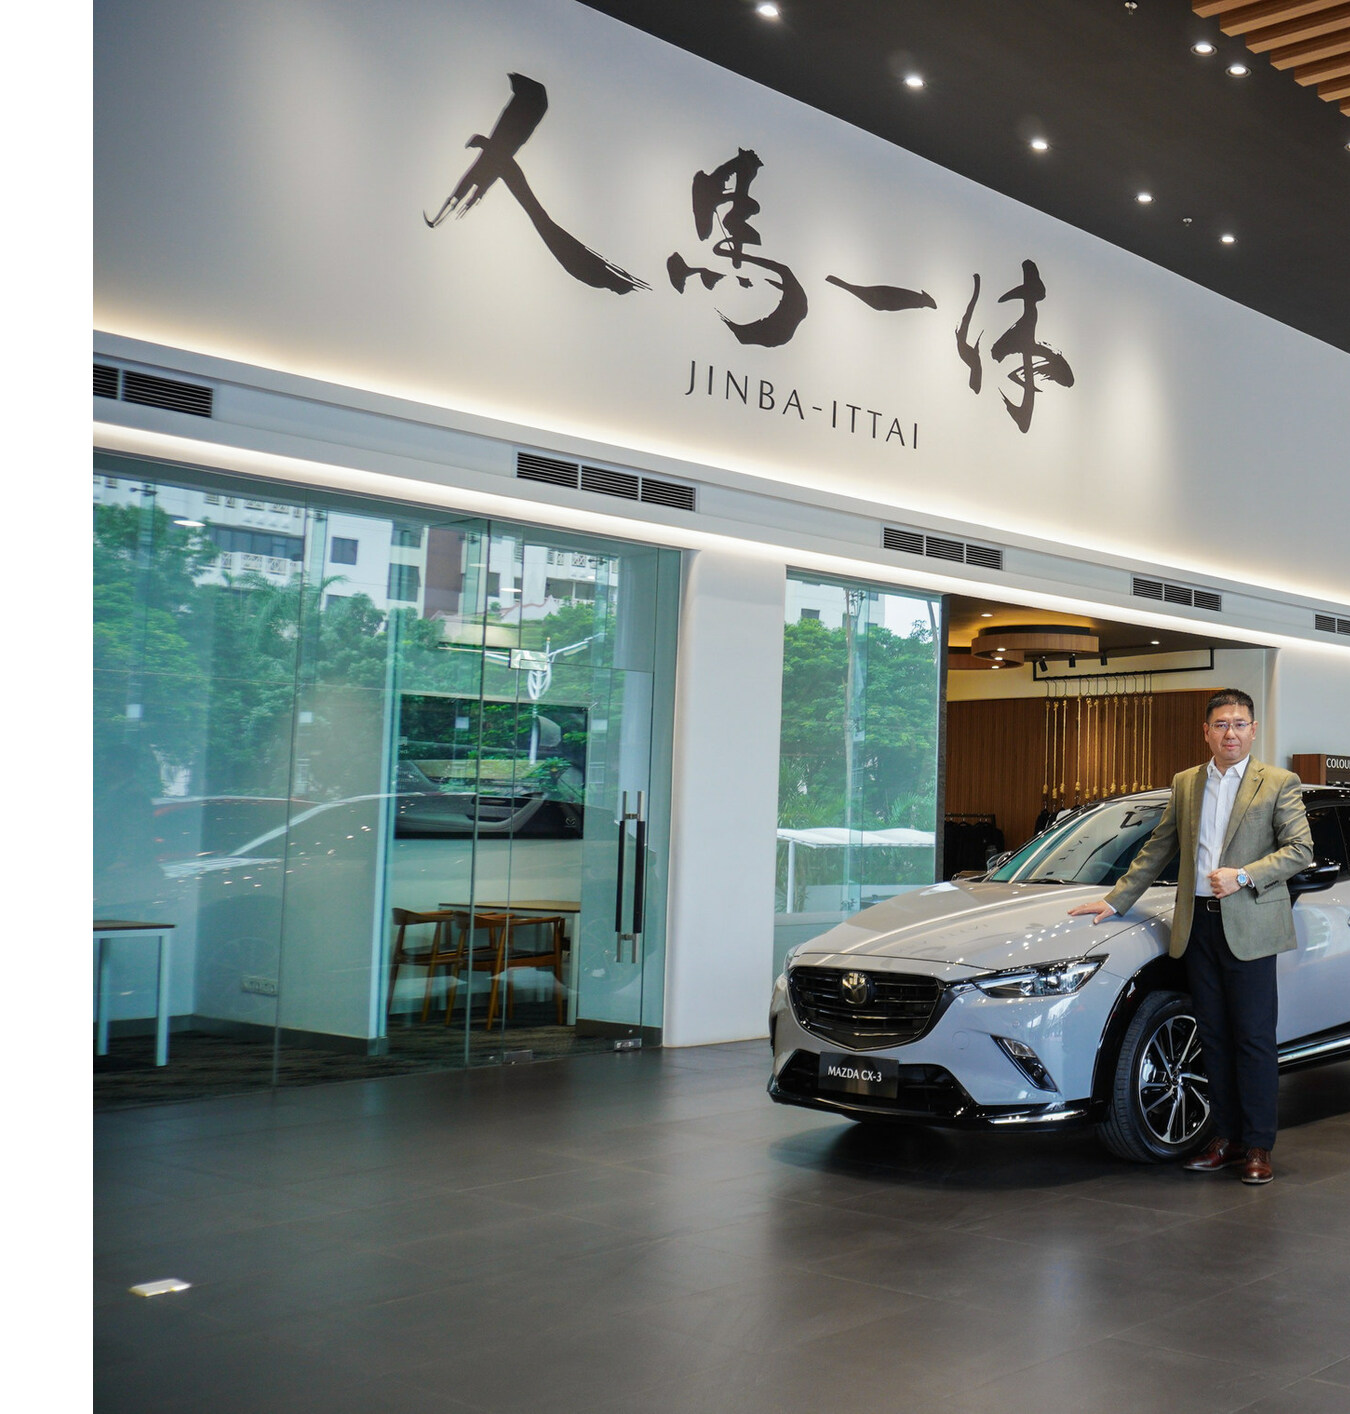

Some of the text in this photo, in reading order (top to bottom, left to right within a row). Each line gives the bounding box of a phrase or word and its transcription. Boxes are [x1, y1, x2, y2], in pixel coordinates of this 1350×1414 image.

[685, 360, 918, 450] JINBA-ITTAI
[827, 1065, 882, 1083] MAZDA CX-3
